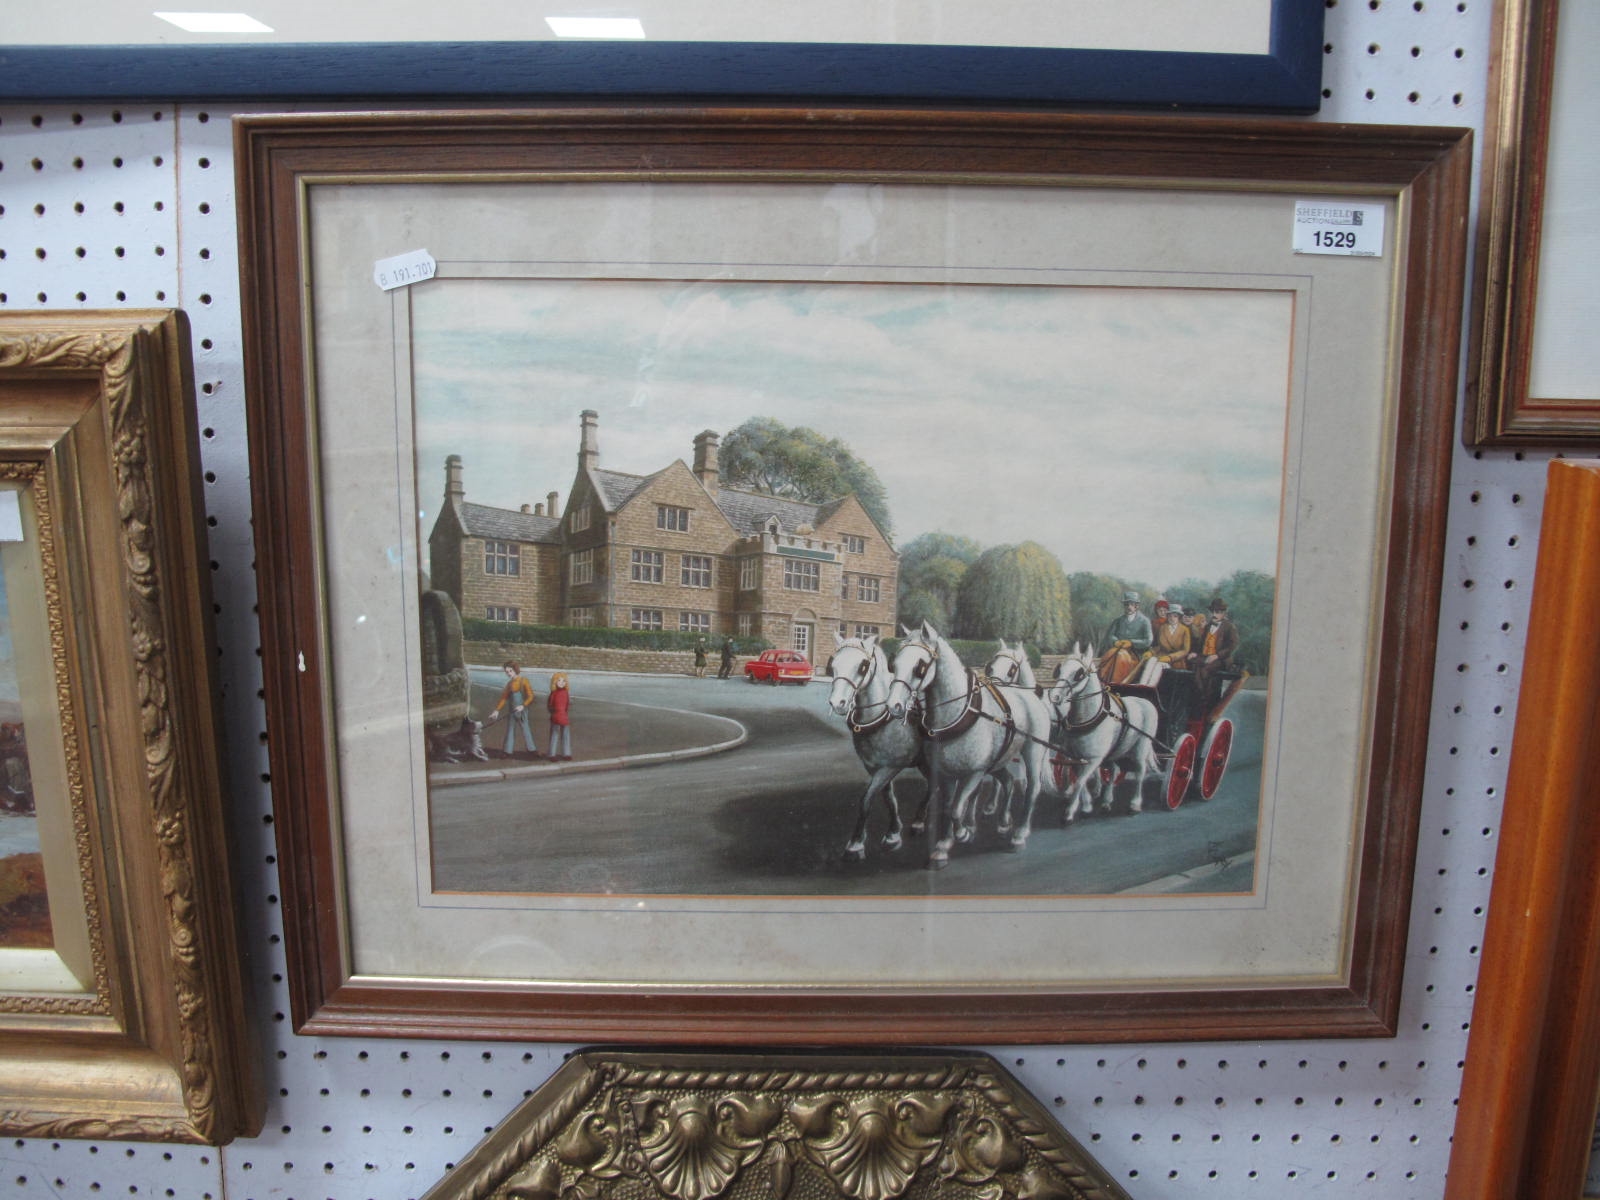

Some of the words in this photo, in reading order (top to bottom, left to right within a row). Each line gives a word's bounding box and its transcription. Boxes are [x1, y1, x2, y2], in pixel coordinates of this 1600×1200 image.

[1296, 207, 1352, 218] SHEFFIELD
[1313, 230, 1356, 248] 1529
[393, 261, 433, 281] 191.701
